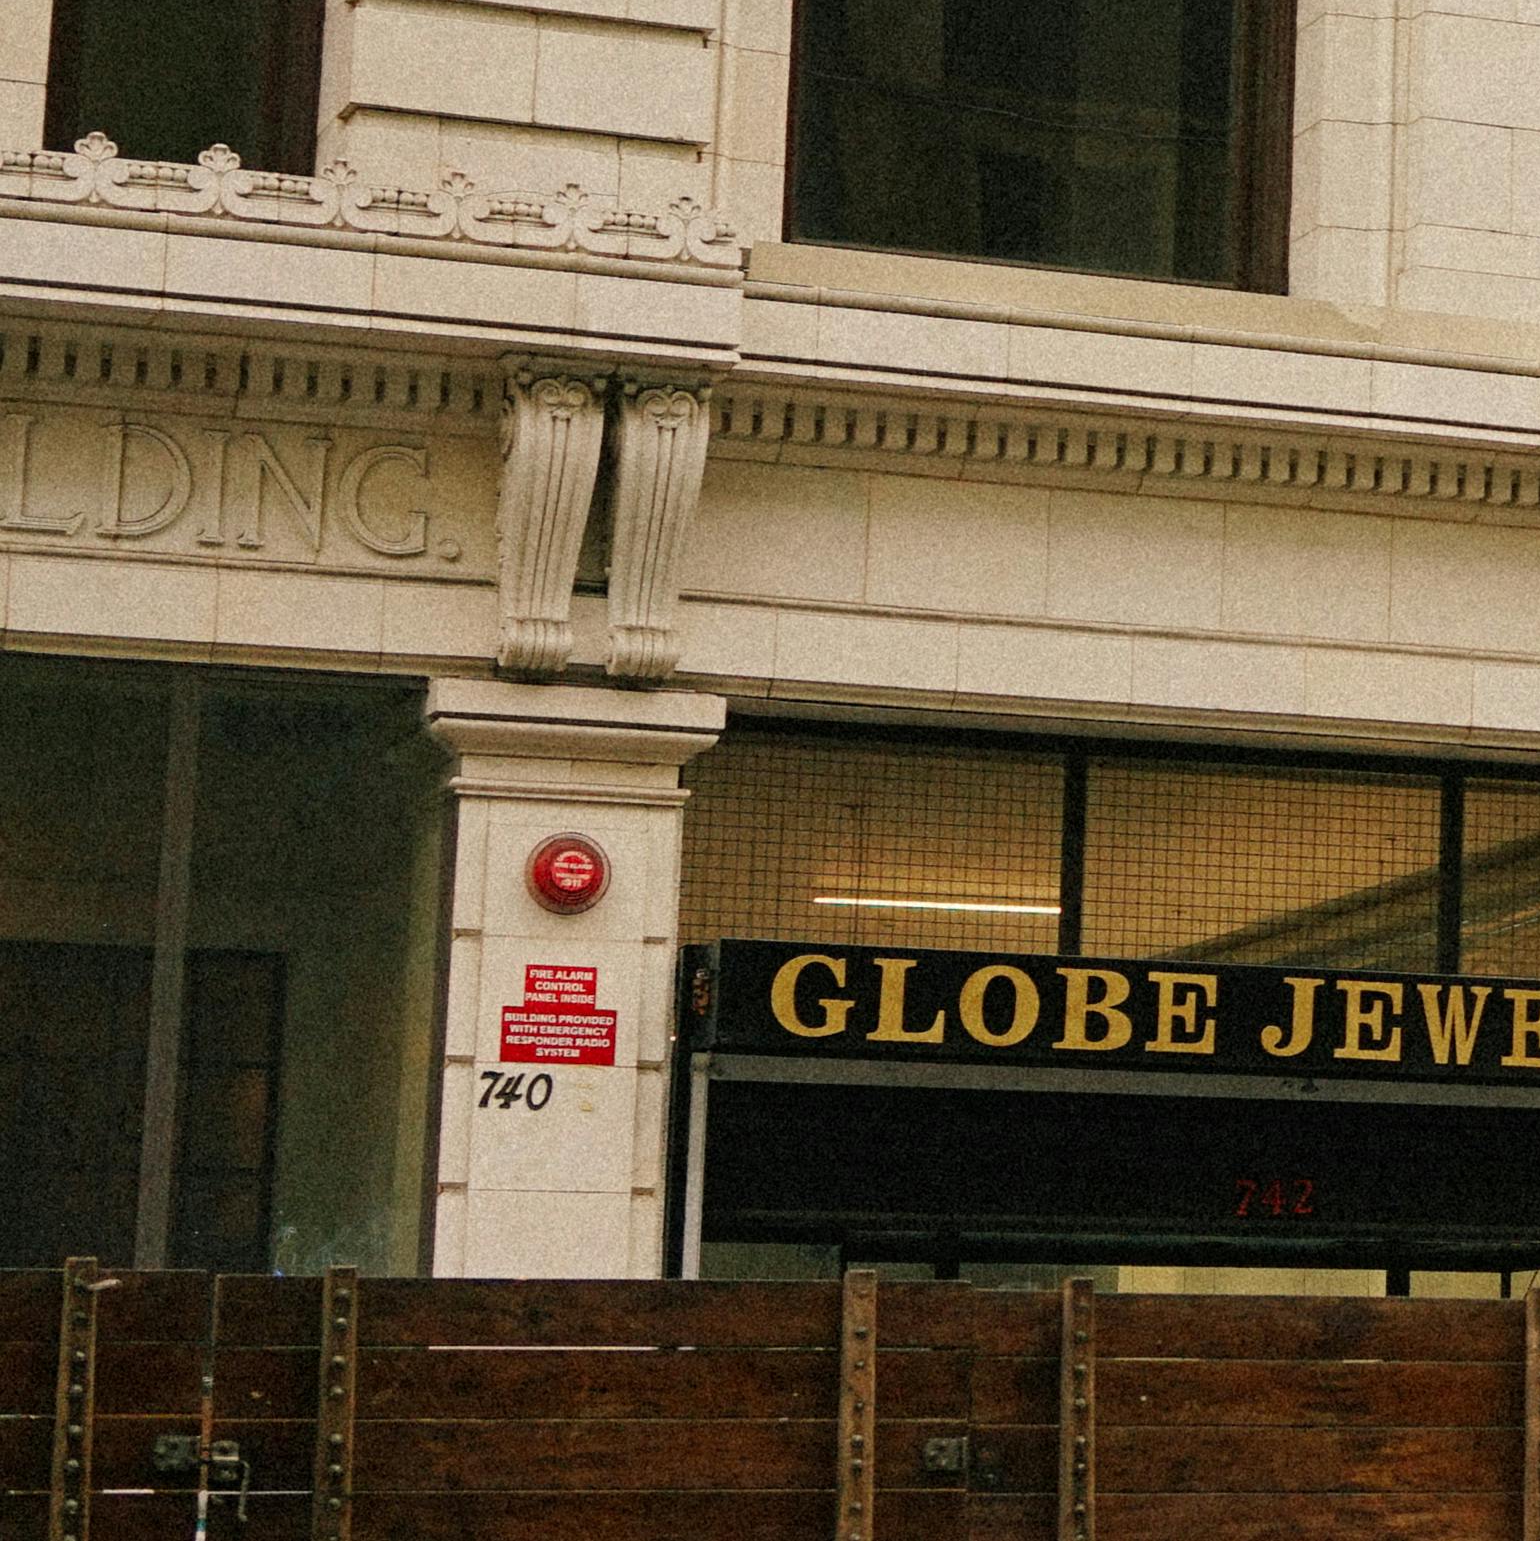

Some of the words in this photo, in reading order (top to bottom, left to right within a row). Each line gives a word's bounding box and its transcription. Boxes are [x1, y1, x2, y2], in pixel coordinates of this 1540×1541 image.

[529, 969, 555, 980] FIRE
[554, 970, 594, 981] ALARM
[534, 980, 587, 992] CONTROL
[525, 992, 559, 1003] PANEL
[560, 994, 595, 1004] INSIDE
[770, 954, 1219, 1055] GLOBE
[504, 1012, 557, 1023] BUILDING
[558, 1014, 615, 1026] PROVIDED
[509, 1024, 538, 1034] WITH
[539, 1026, 609, 1036] EMERGENCY
[505, 1035, 575, 1047] RESPONDER
[574, 1038, 611, 1048] RADIO
[535, 1047, 581, 1058] SYSTEM
[478, 1070, 553, 1112] 740
[1235, 1178, 1313, 1217] 742
